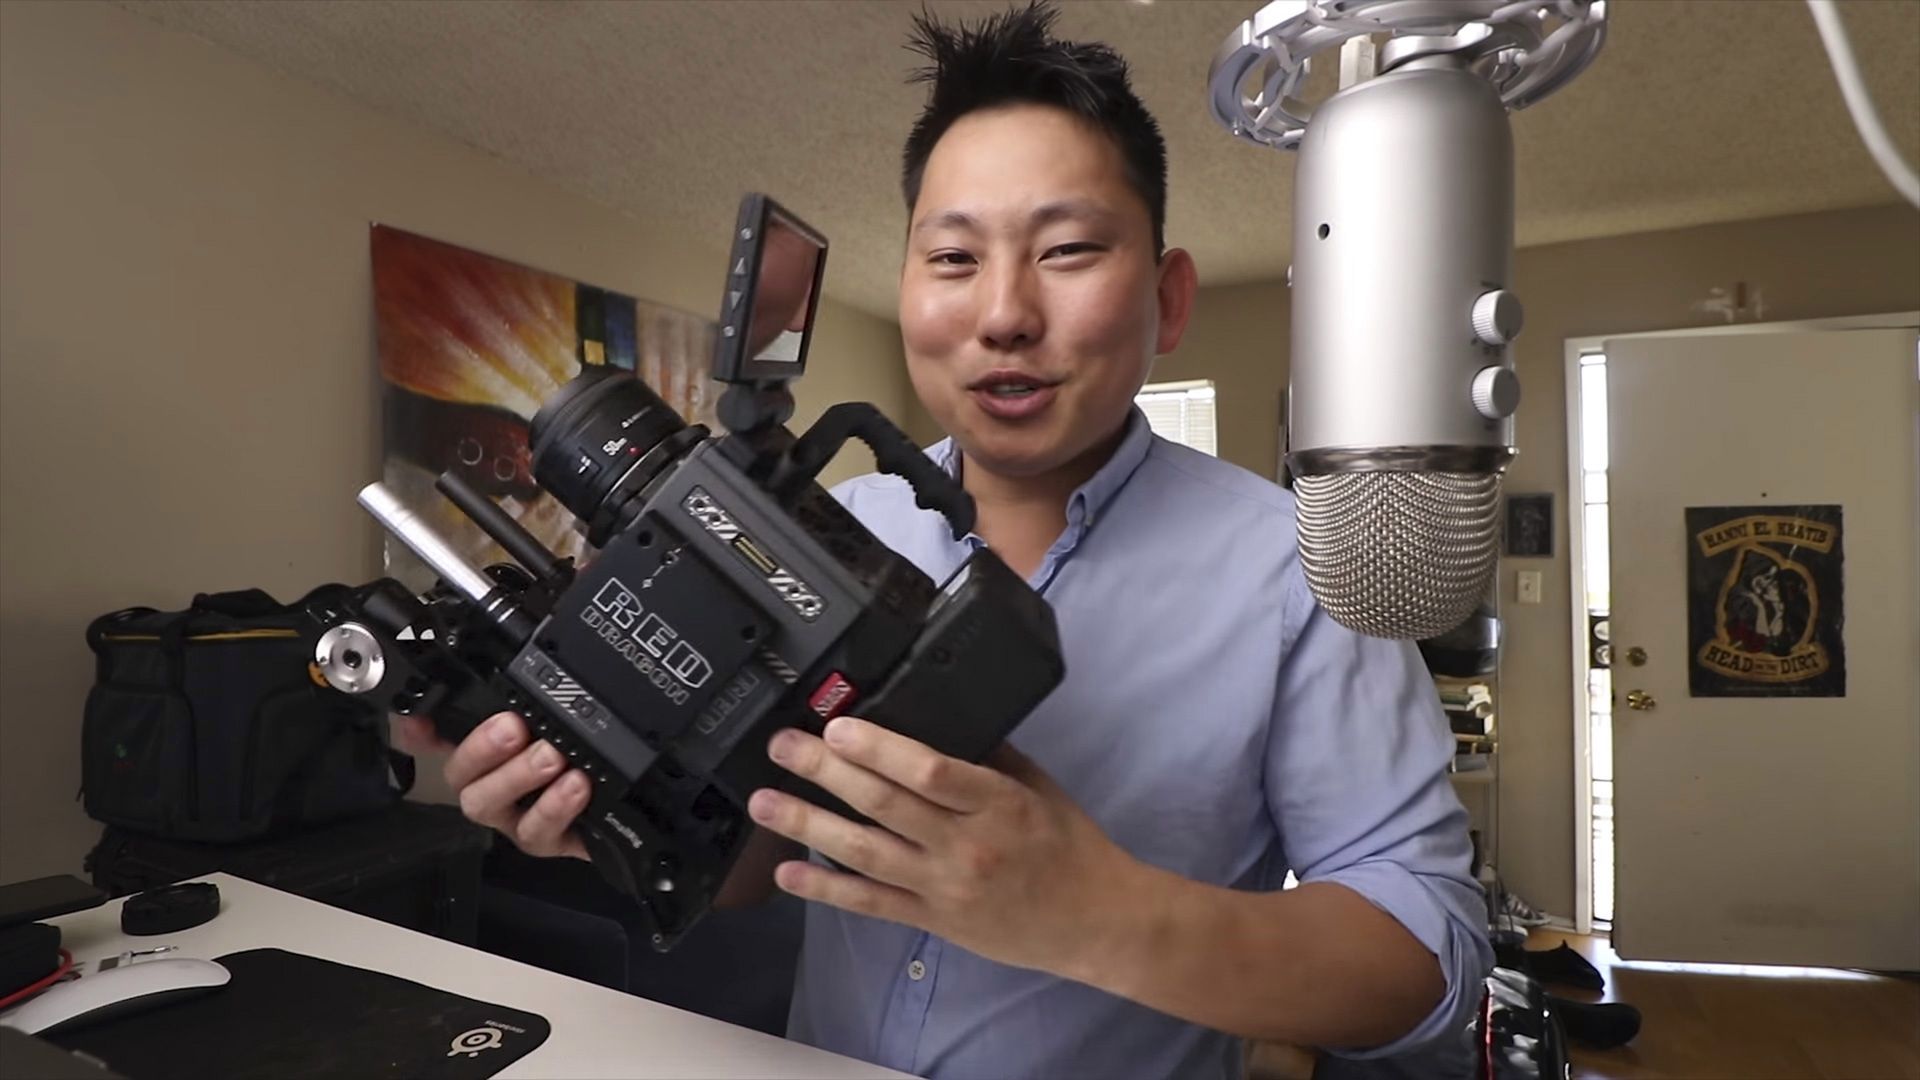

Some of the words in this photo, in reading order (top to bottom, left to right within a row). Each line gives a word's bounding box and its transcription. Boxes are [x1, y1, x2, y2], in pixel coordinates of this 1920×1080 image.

[1752, 521, 1771, 536] EL
[580, 605, 690, 705] DRAGON
[592, 577, 713, 688] RED
[1704, 646, 1754, 673] HEAD
[1780, 652, 1819, 674] DIRT
